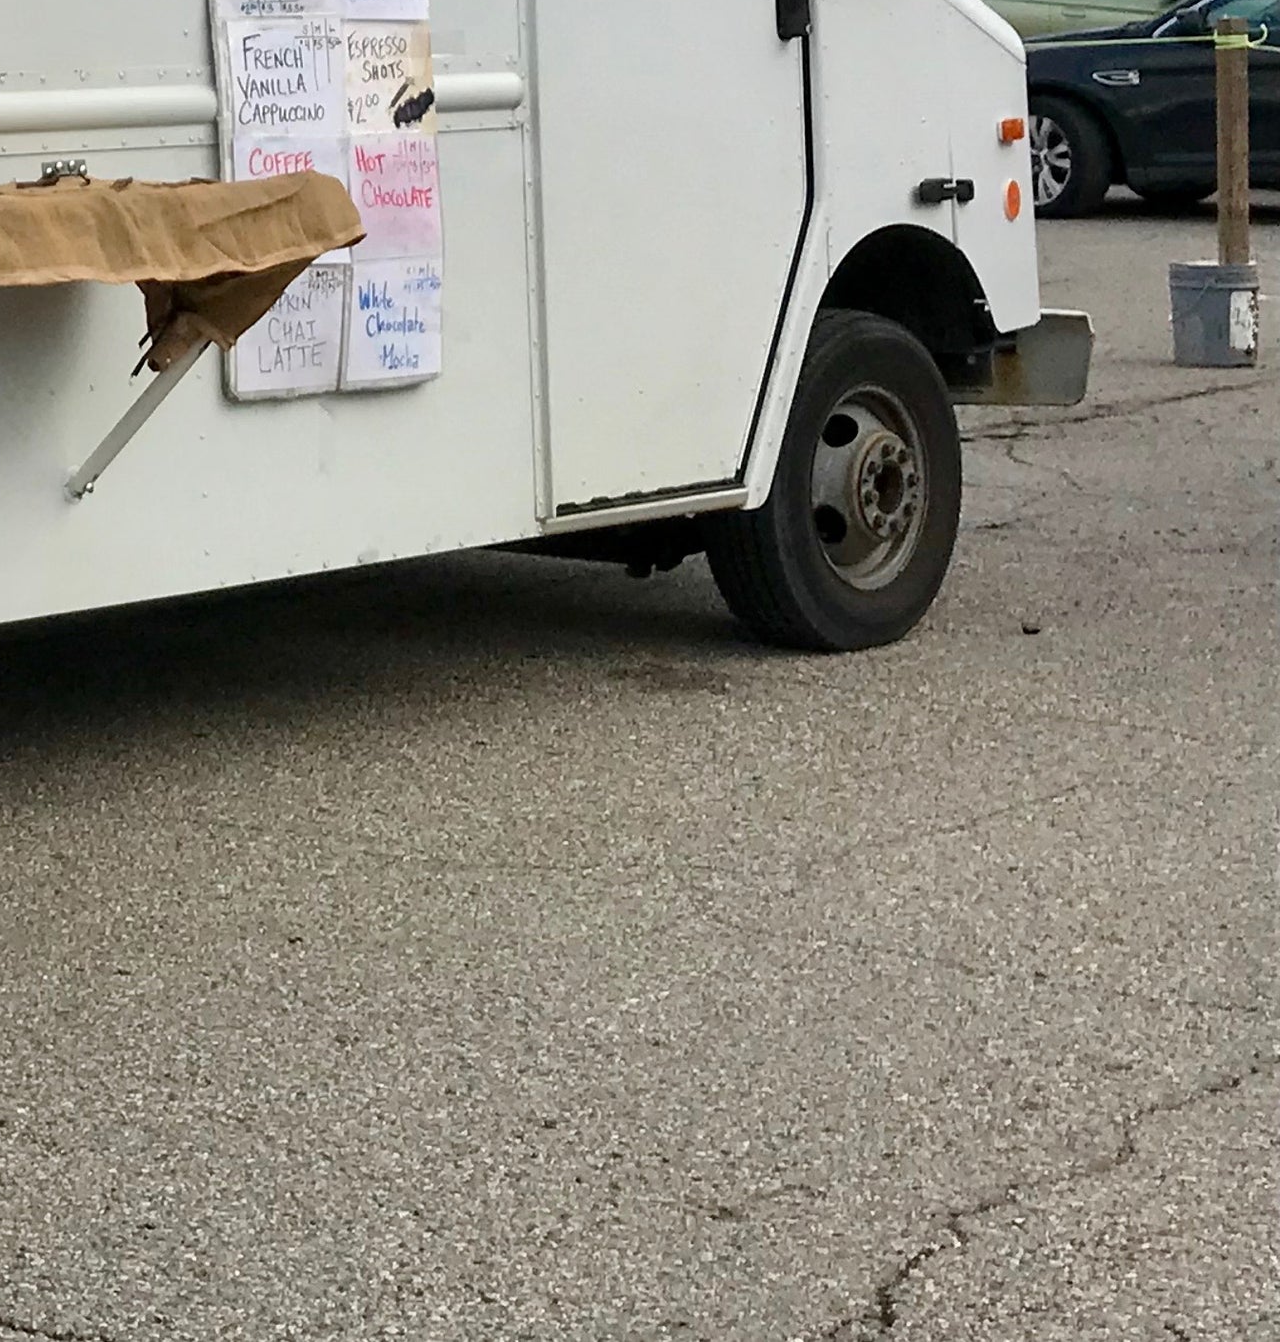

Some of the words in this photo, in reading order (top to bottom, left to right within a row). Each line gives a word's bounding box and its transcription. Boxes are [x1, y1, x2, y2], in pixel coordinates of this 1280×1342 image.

[242, 33, 305, 71] FRENCH
[347, 30, 408, 60] ESPRESSO
[237, 73, 307, 100] VANILLA
[361, 60, 405, 83] SHOTS
[239, 101, 325, 127] CAPPUCCINO
[248, 147, 314, 176] COFFEE
[354, 145, 386, 175] HOT
[361, 178, 433, 209] CHOCOLATE
[358, 278, 395, 311] White
[267, 316, 317, 344] CHAI
[365, 306, 426, 338] Chocolate
[257, 340, 327, 374] LATTE
[379, 342, 420, 371] Mocha
